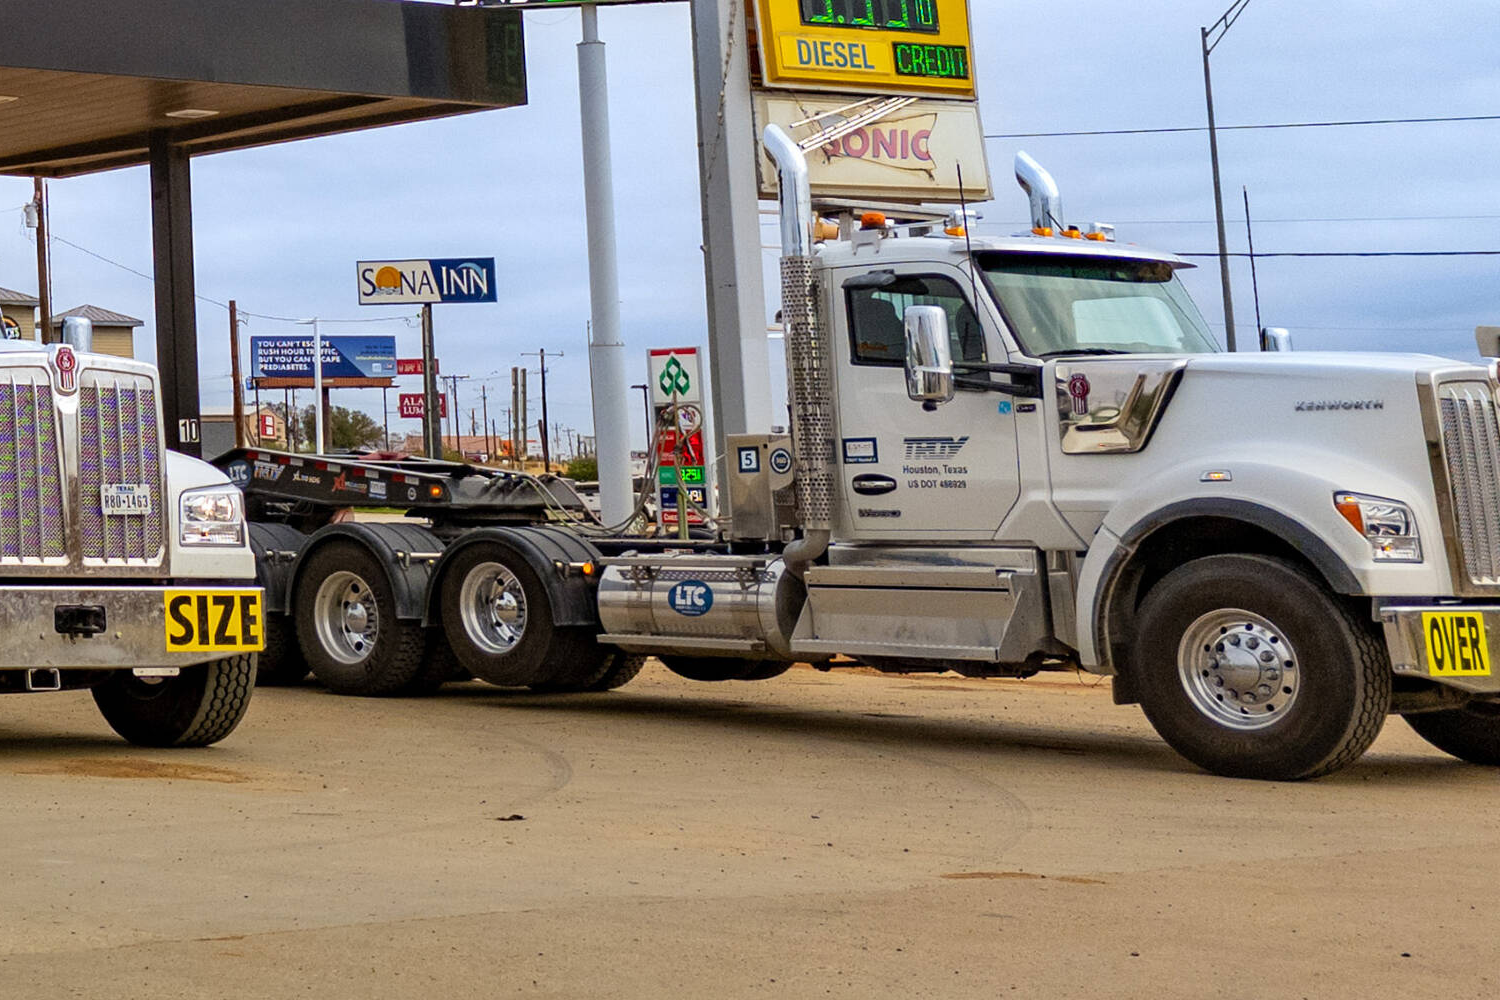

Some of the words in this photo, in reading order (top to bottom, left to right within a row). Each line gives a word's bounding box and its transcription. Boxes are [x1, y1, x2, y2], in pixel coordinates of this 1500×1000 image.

[796, 39, 875, 70] DIESEL
[897, 44, 965, 76] CREDIT
[441, 265, 488, 295] INN
[306, 348, 339, 356] TRFFIC,
[181, 420, 198, 441] 10
[744, 453, 752, 467] 5
[942, 464, 968, 474] Texas
[228, 465, 248, 481] LTC
[908, 480, 920, 489] US
[921, 480, 937, 489] DOT
[675, 585, 706, 606] LTC
[169, 595, 260, 646] SIZE
[1430, 616, 1485, 671] OVER
